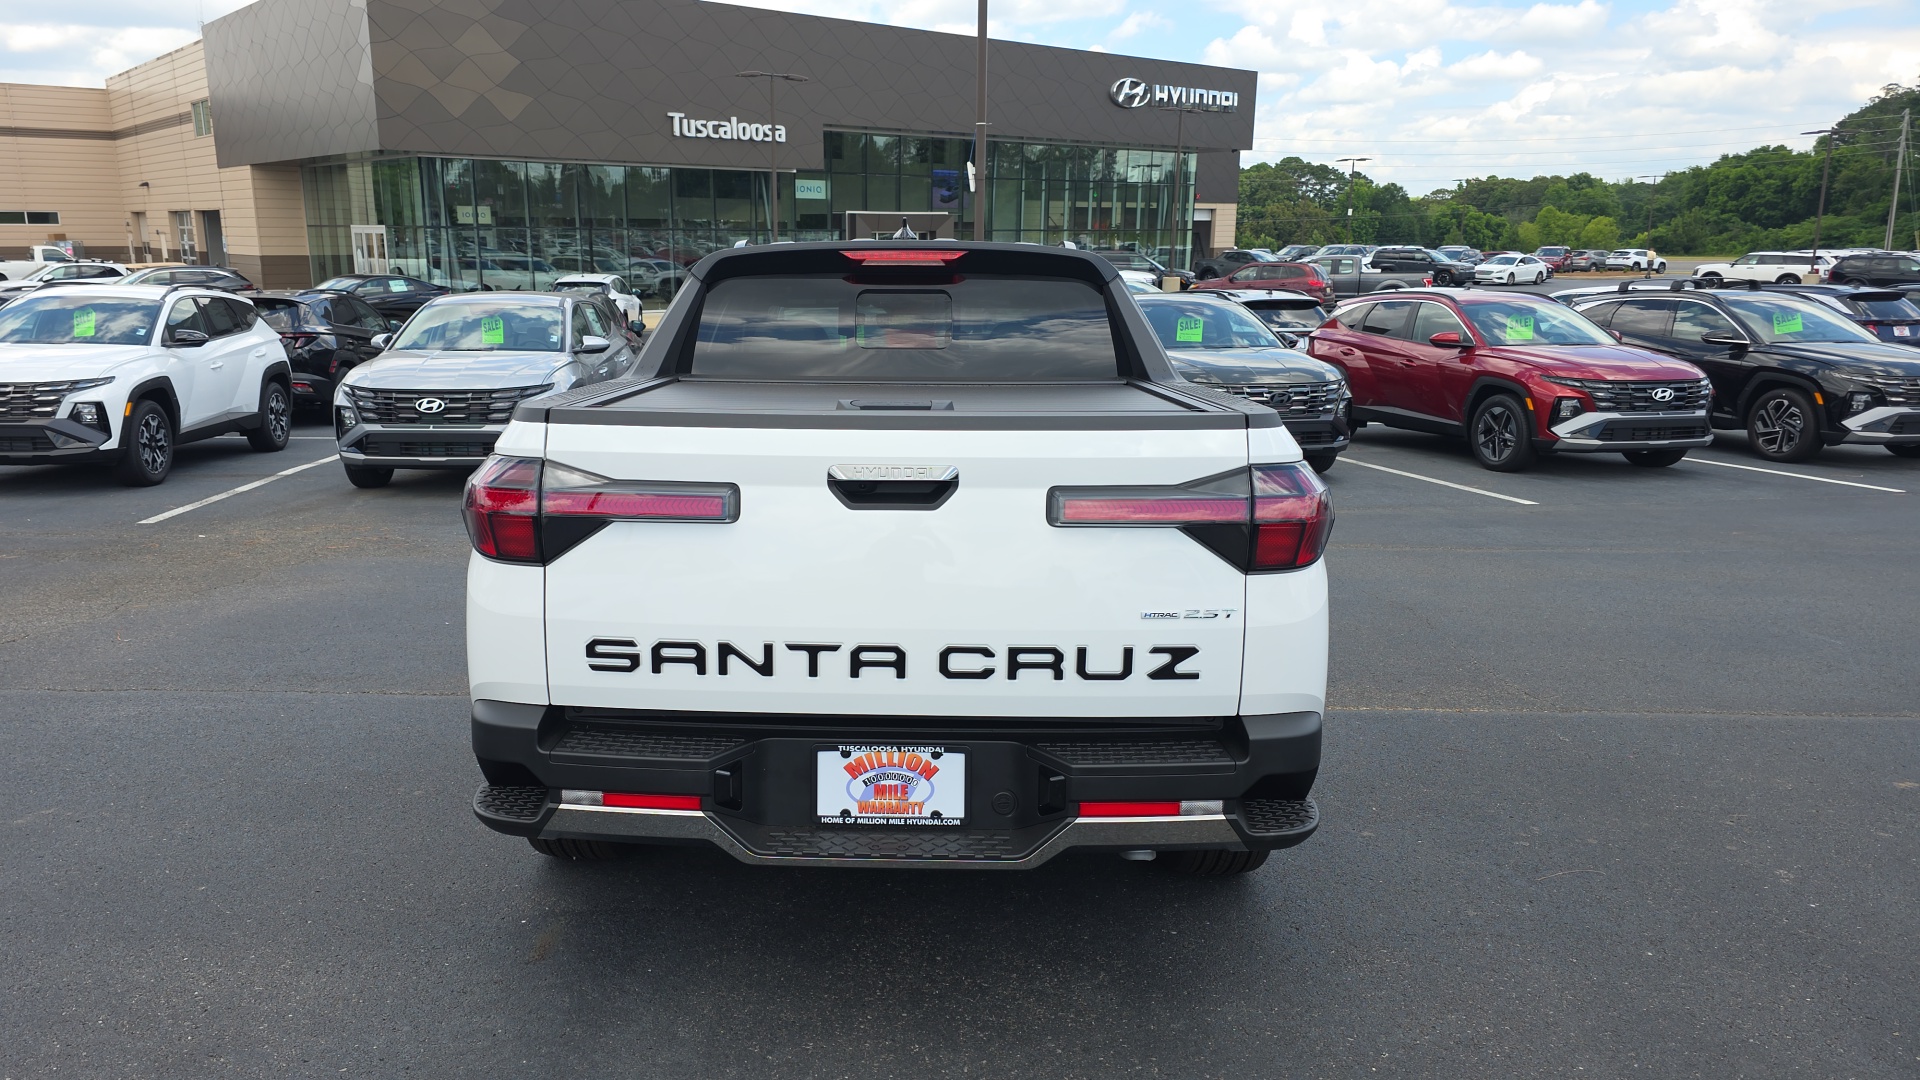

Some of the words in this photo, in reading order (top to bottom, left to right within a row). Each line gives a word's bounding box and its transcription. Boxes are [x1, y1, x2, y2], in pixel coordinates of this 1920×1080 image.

[1153, 85, 1238, 112] HYUNDAI
[667, 112, 786, 143] Tuscaloosa
[796, 185, 822, 194] IONIQ
[483, 319, 501, 333] SALE!
[1180, 319, 1201, 331] SALE!
[854, 466, 933, 479] HYUNDAI
[585, 636, 908, 679] SANTA
[938, 645, 1200, 680] CRUZ
[843, 751, 940, 781] MILLION
[873, 784, 909, 801] MILE
[857, 801, 924, 815] WARRANTY
[821, 816, 843, 824] HOME
[857, 817, 887, 825] MILLION
[906, 818, 961, 826] HYUNDAI.COM
